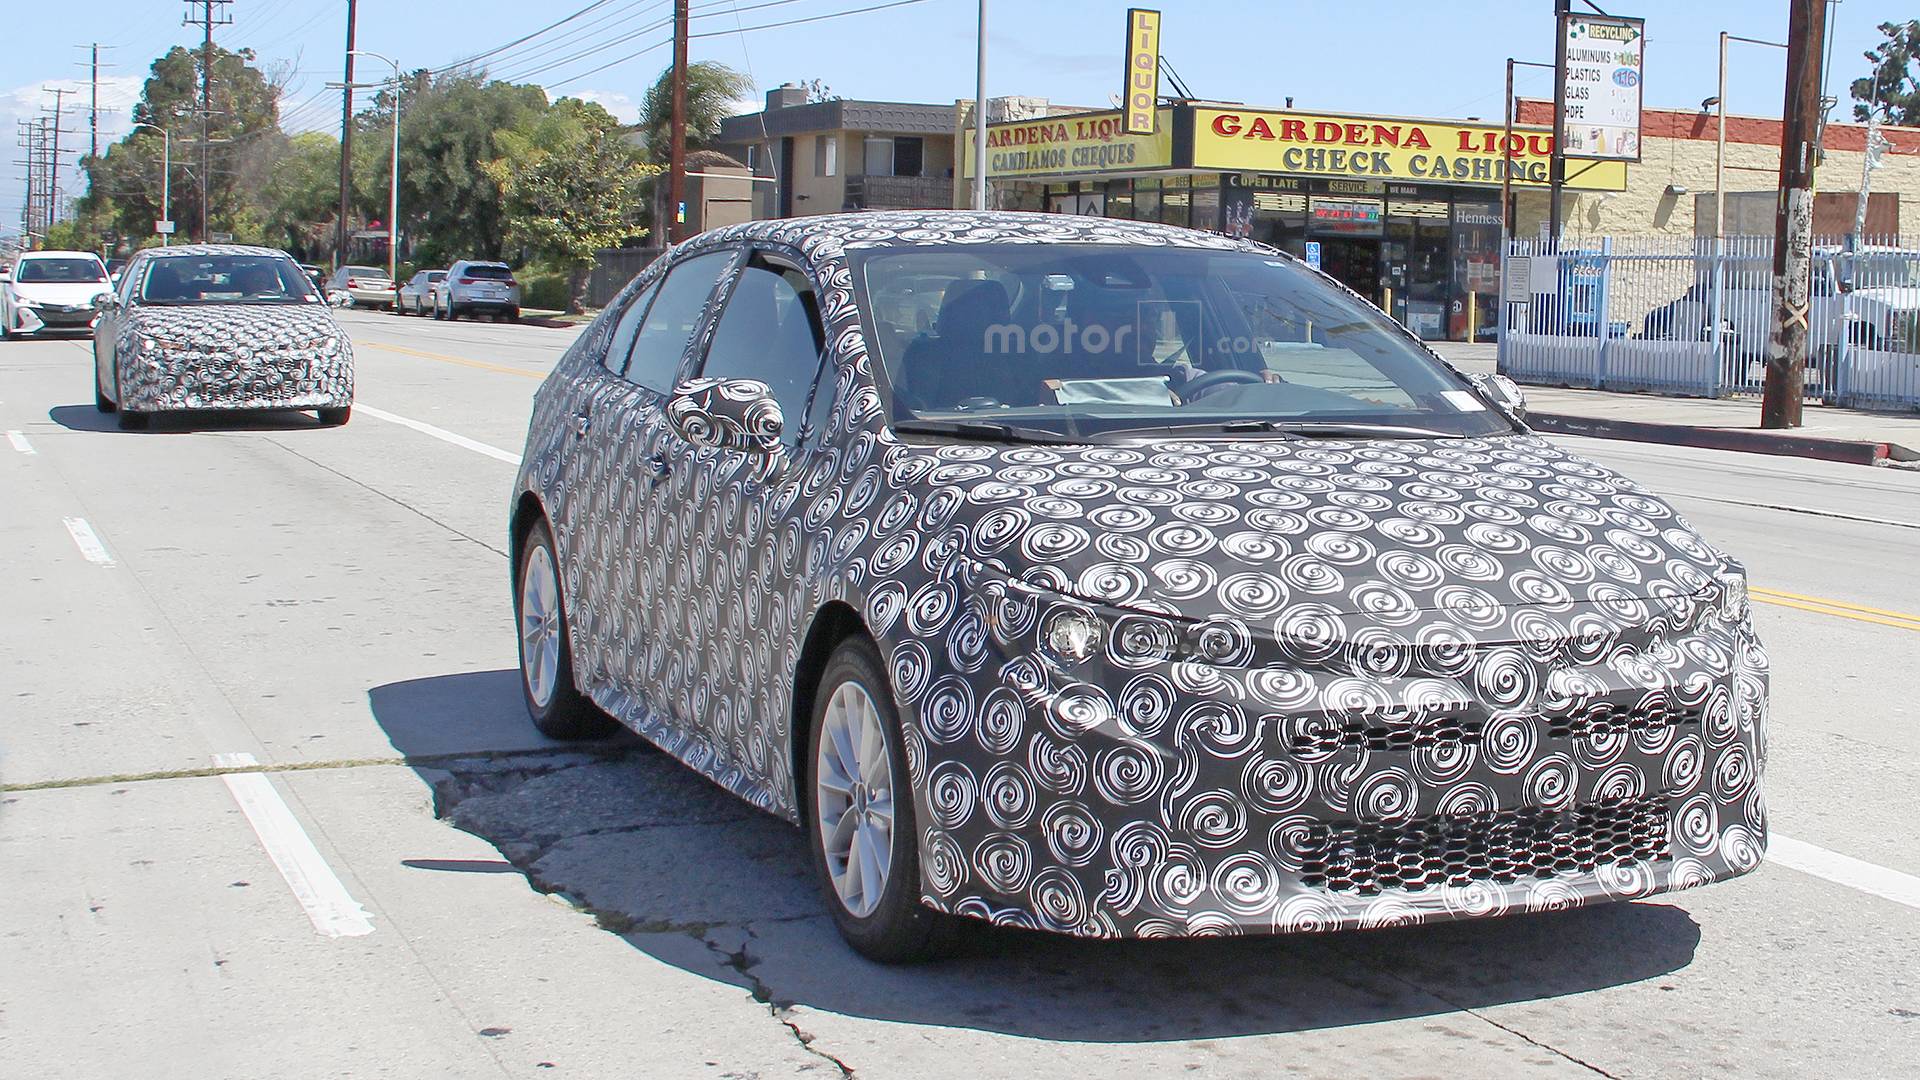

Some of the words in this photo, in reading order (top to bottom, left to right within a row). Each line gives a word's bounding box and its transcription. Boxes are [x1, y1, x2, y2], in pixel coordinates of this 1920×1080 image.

[1589, 24, 1634, 41] RECYCLING
[1566, 47, 1611, 64] ALUMINUMS
[1133, 14, 1153, 129] LIQUOR
[1565, 67, 1601, 82] PLASTICS
[1565, 86, 1590, 101] GLASS
[973, 124, 1069, 149] ARDENA
[1211, 114, 1432, 150] GARDENA
[1456, 130, 1555, 159] LIQU
[992, 149, 1066, 172] CAMBIAMOS
[1072, 144, 1136, 168] CHEQUES
[1282, 147, 1393, 175] CHECK
[1408, 154, 1548, 182] CASHING
[1240, 177, 1269, 188] OPEN
[1272, 178, 1299, 190] LATE
[1331, 181, 1369, 193] SERVICE
[1455, 210, 1505, 225] Henness
